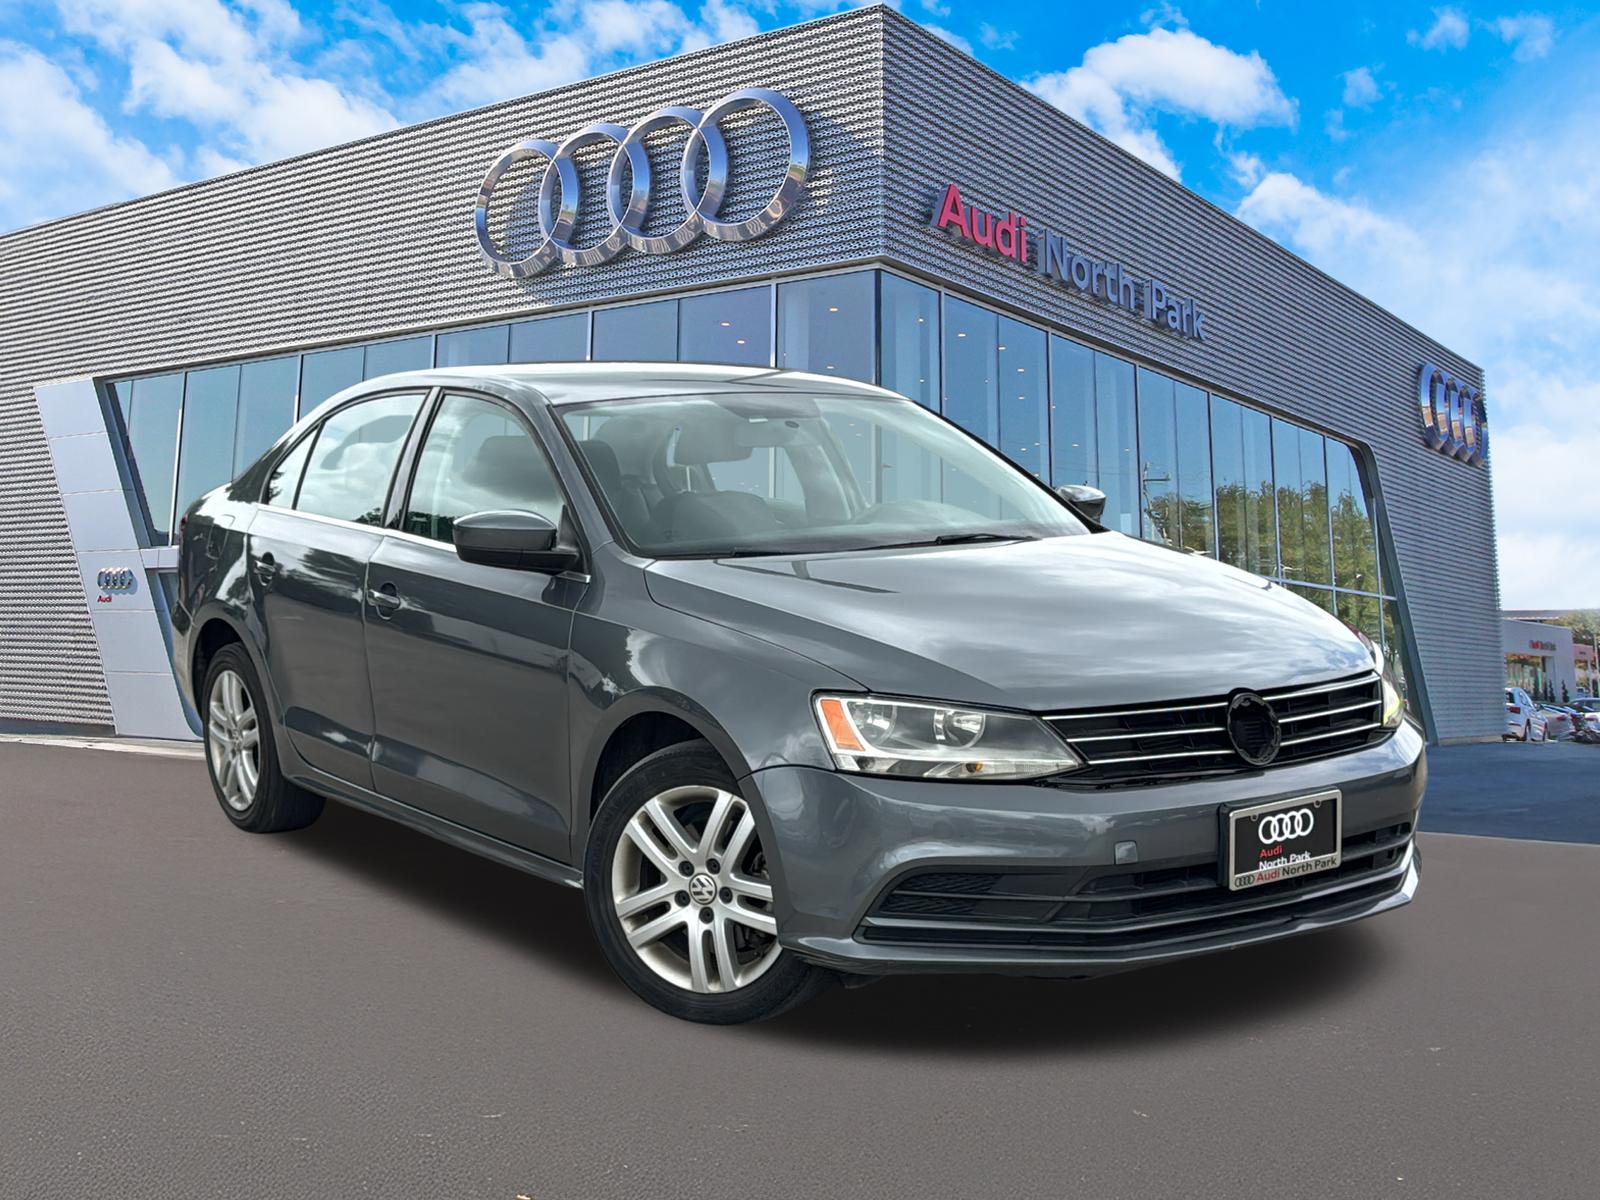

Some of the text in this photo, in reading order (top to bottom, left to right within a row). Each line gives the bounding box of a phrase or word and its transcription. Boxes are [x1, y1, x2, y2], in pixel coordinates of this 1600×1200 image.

[931, 183, 1208, 341] Audi North Park
[1259, 846, 1282, 857] Audi
[1259, 851, 1311, 870] North Park
[1256, 857, 1337, 882] Audi North Park
